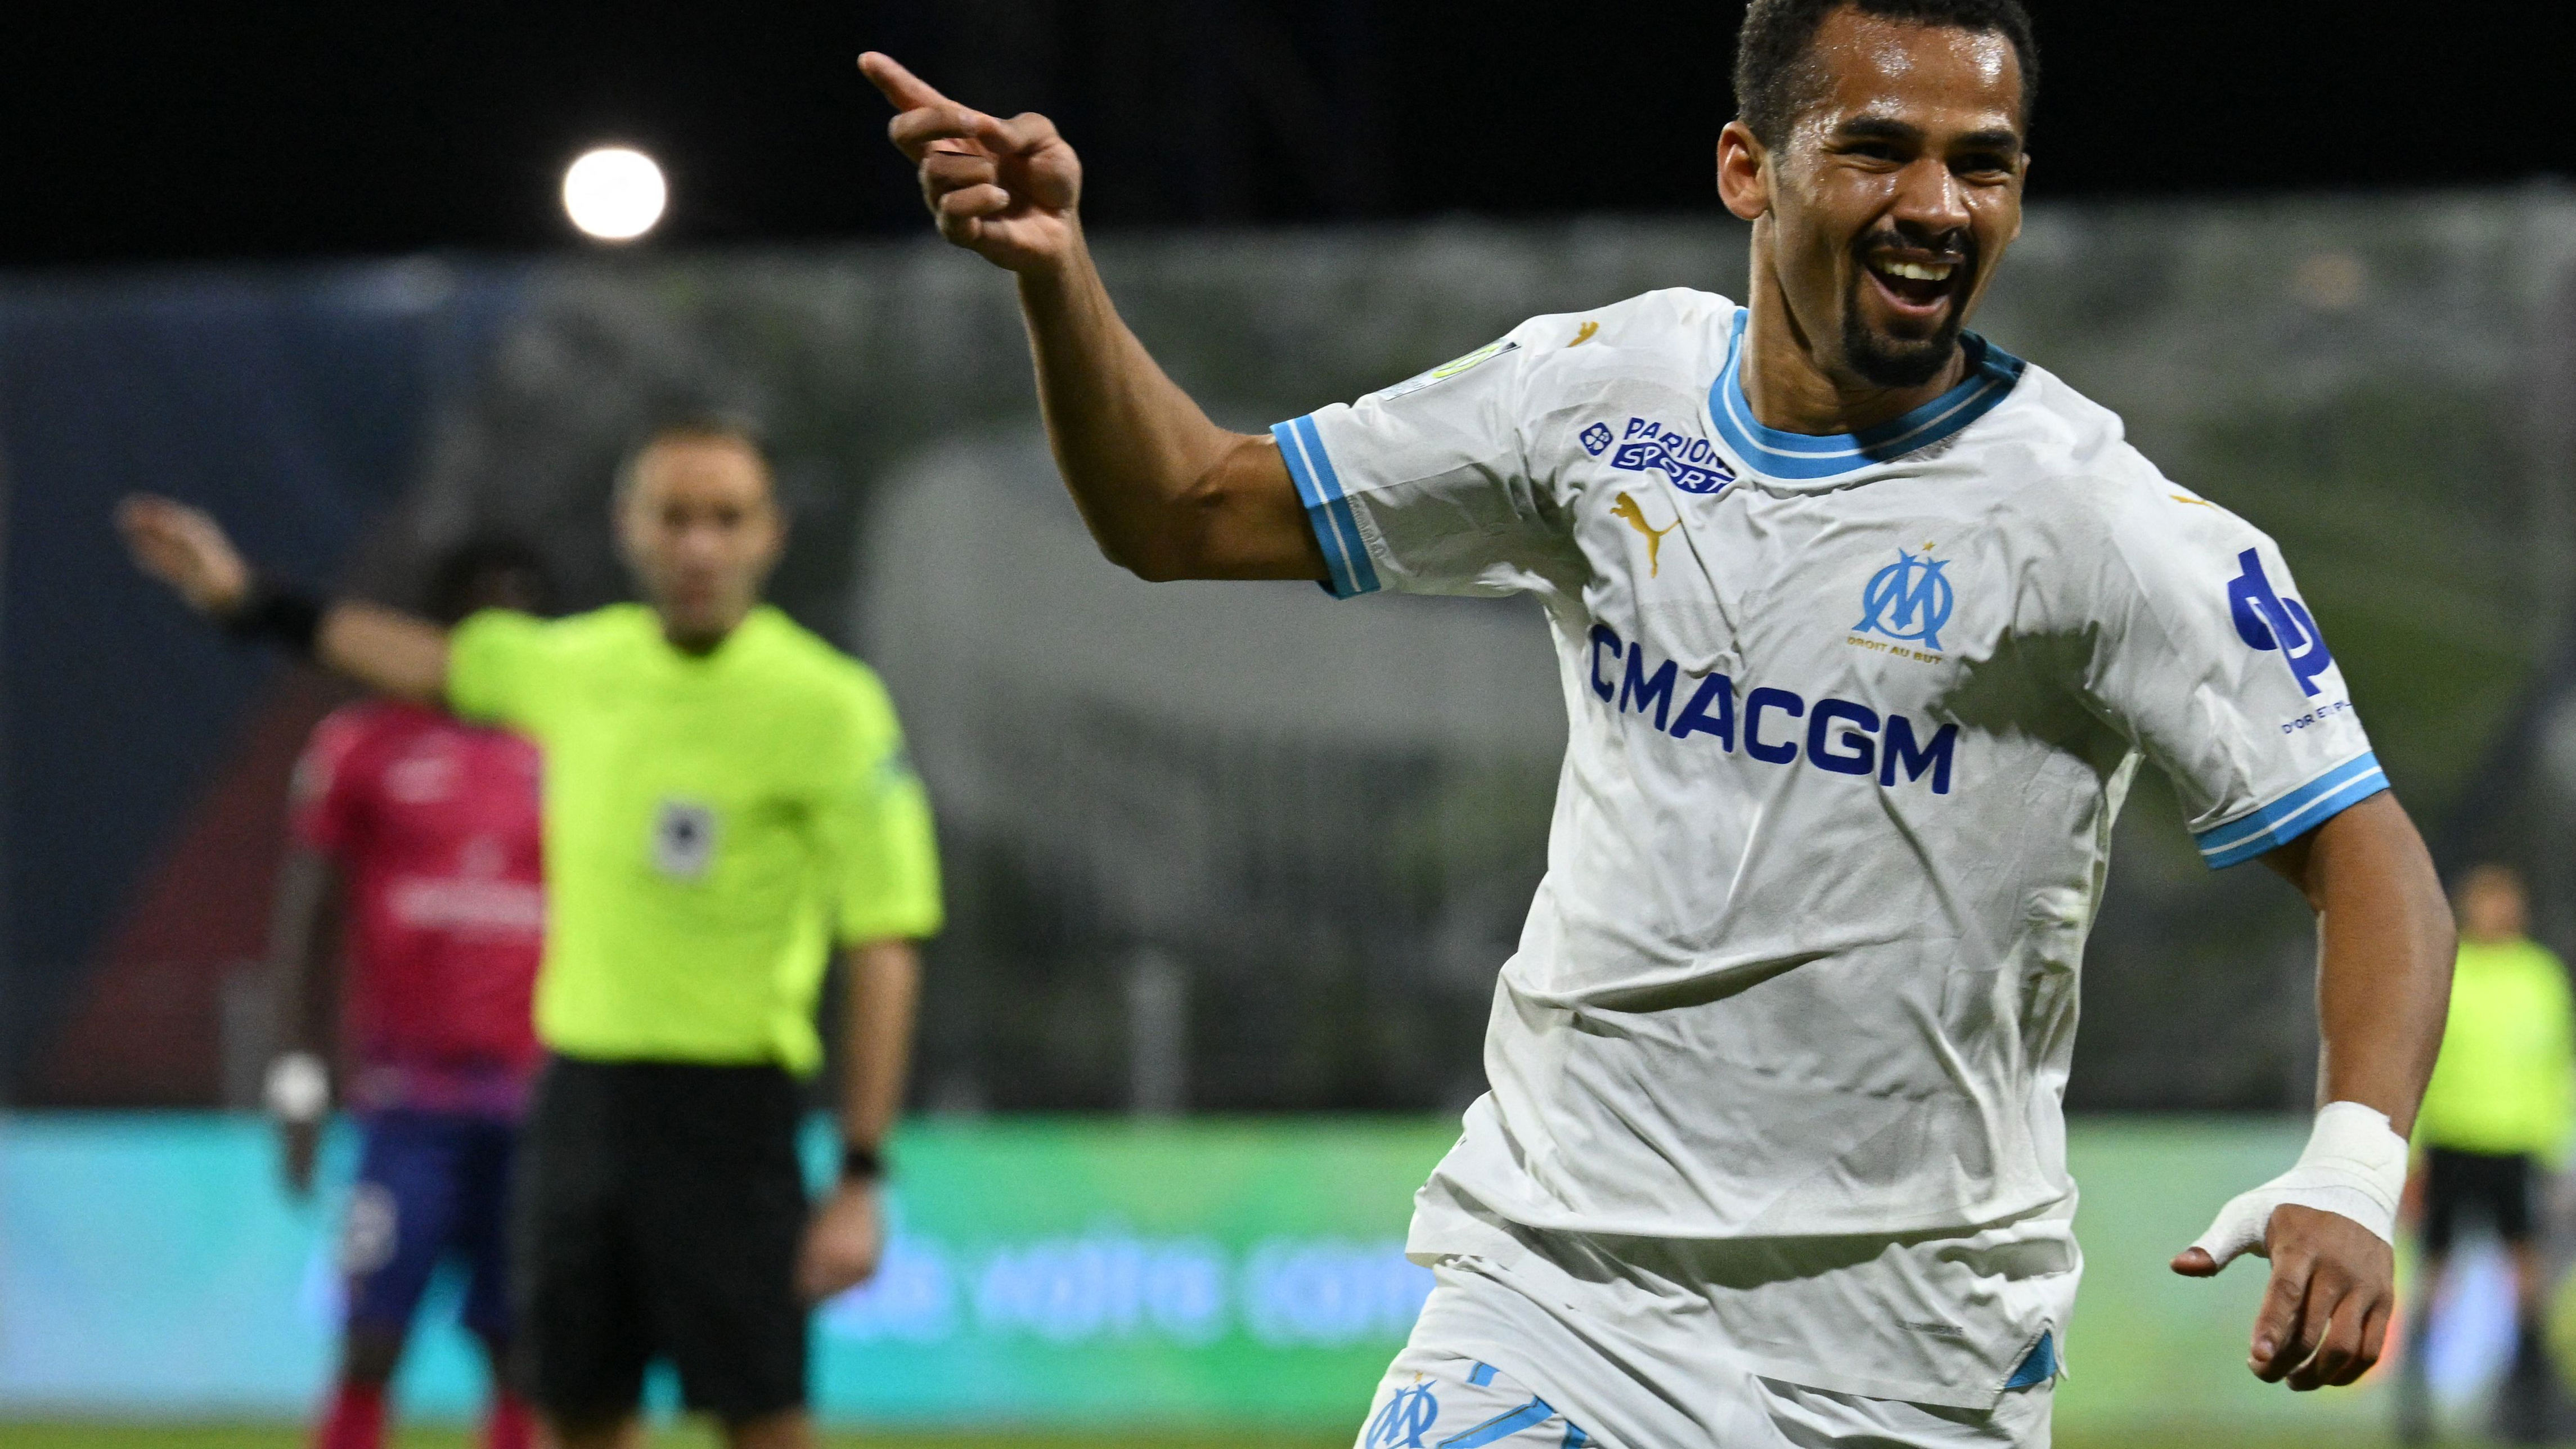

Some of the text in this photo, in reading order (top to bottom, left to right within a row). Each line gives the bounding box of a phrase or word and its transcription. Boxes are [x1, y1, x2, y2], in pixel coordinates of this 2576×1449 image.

[1618, 446, 1729, 492] SPORT
[1847, 637, 1943, 664] DROIT AU BUT
